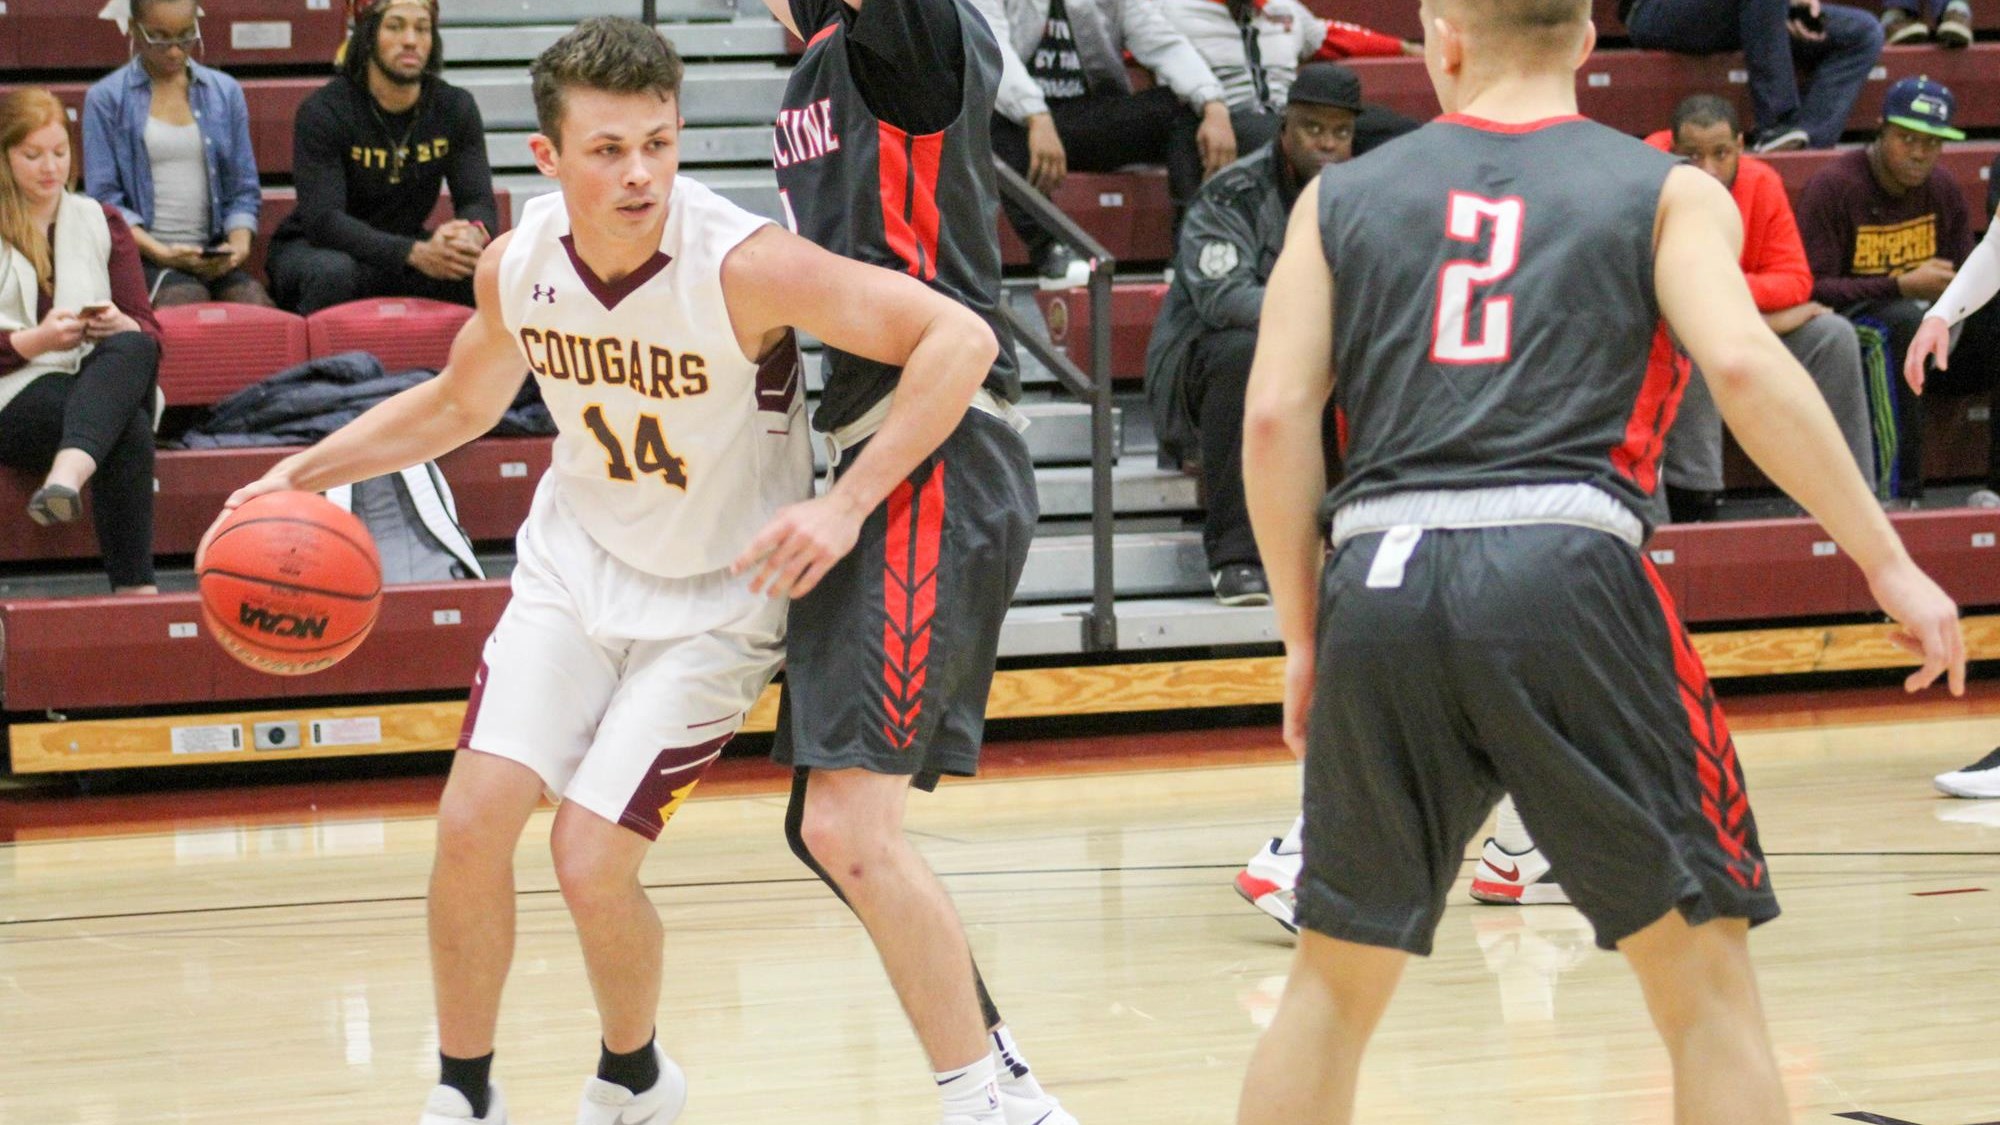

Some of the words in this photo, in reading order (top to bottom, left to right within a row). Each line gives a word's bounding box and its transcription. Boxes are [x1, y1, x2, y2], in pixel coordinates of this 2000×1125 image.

[773, 98, 840, 169] CTINE
[1428, 187, 1525, 365] 2
[519, 326, 710, 399] COUGARS
[582, 402, 689, 492] 14
[239, 602, 329, 639] NCAA
